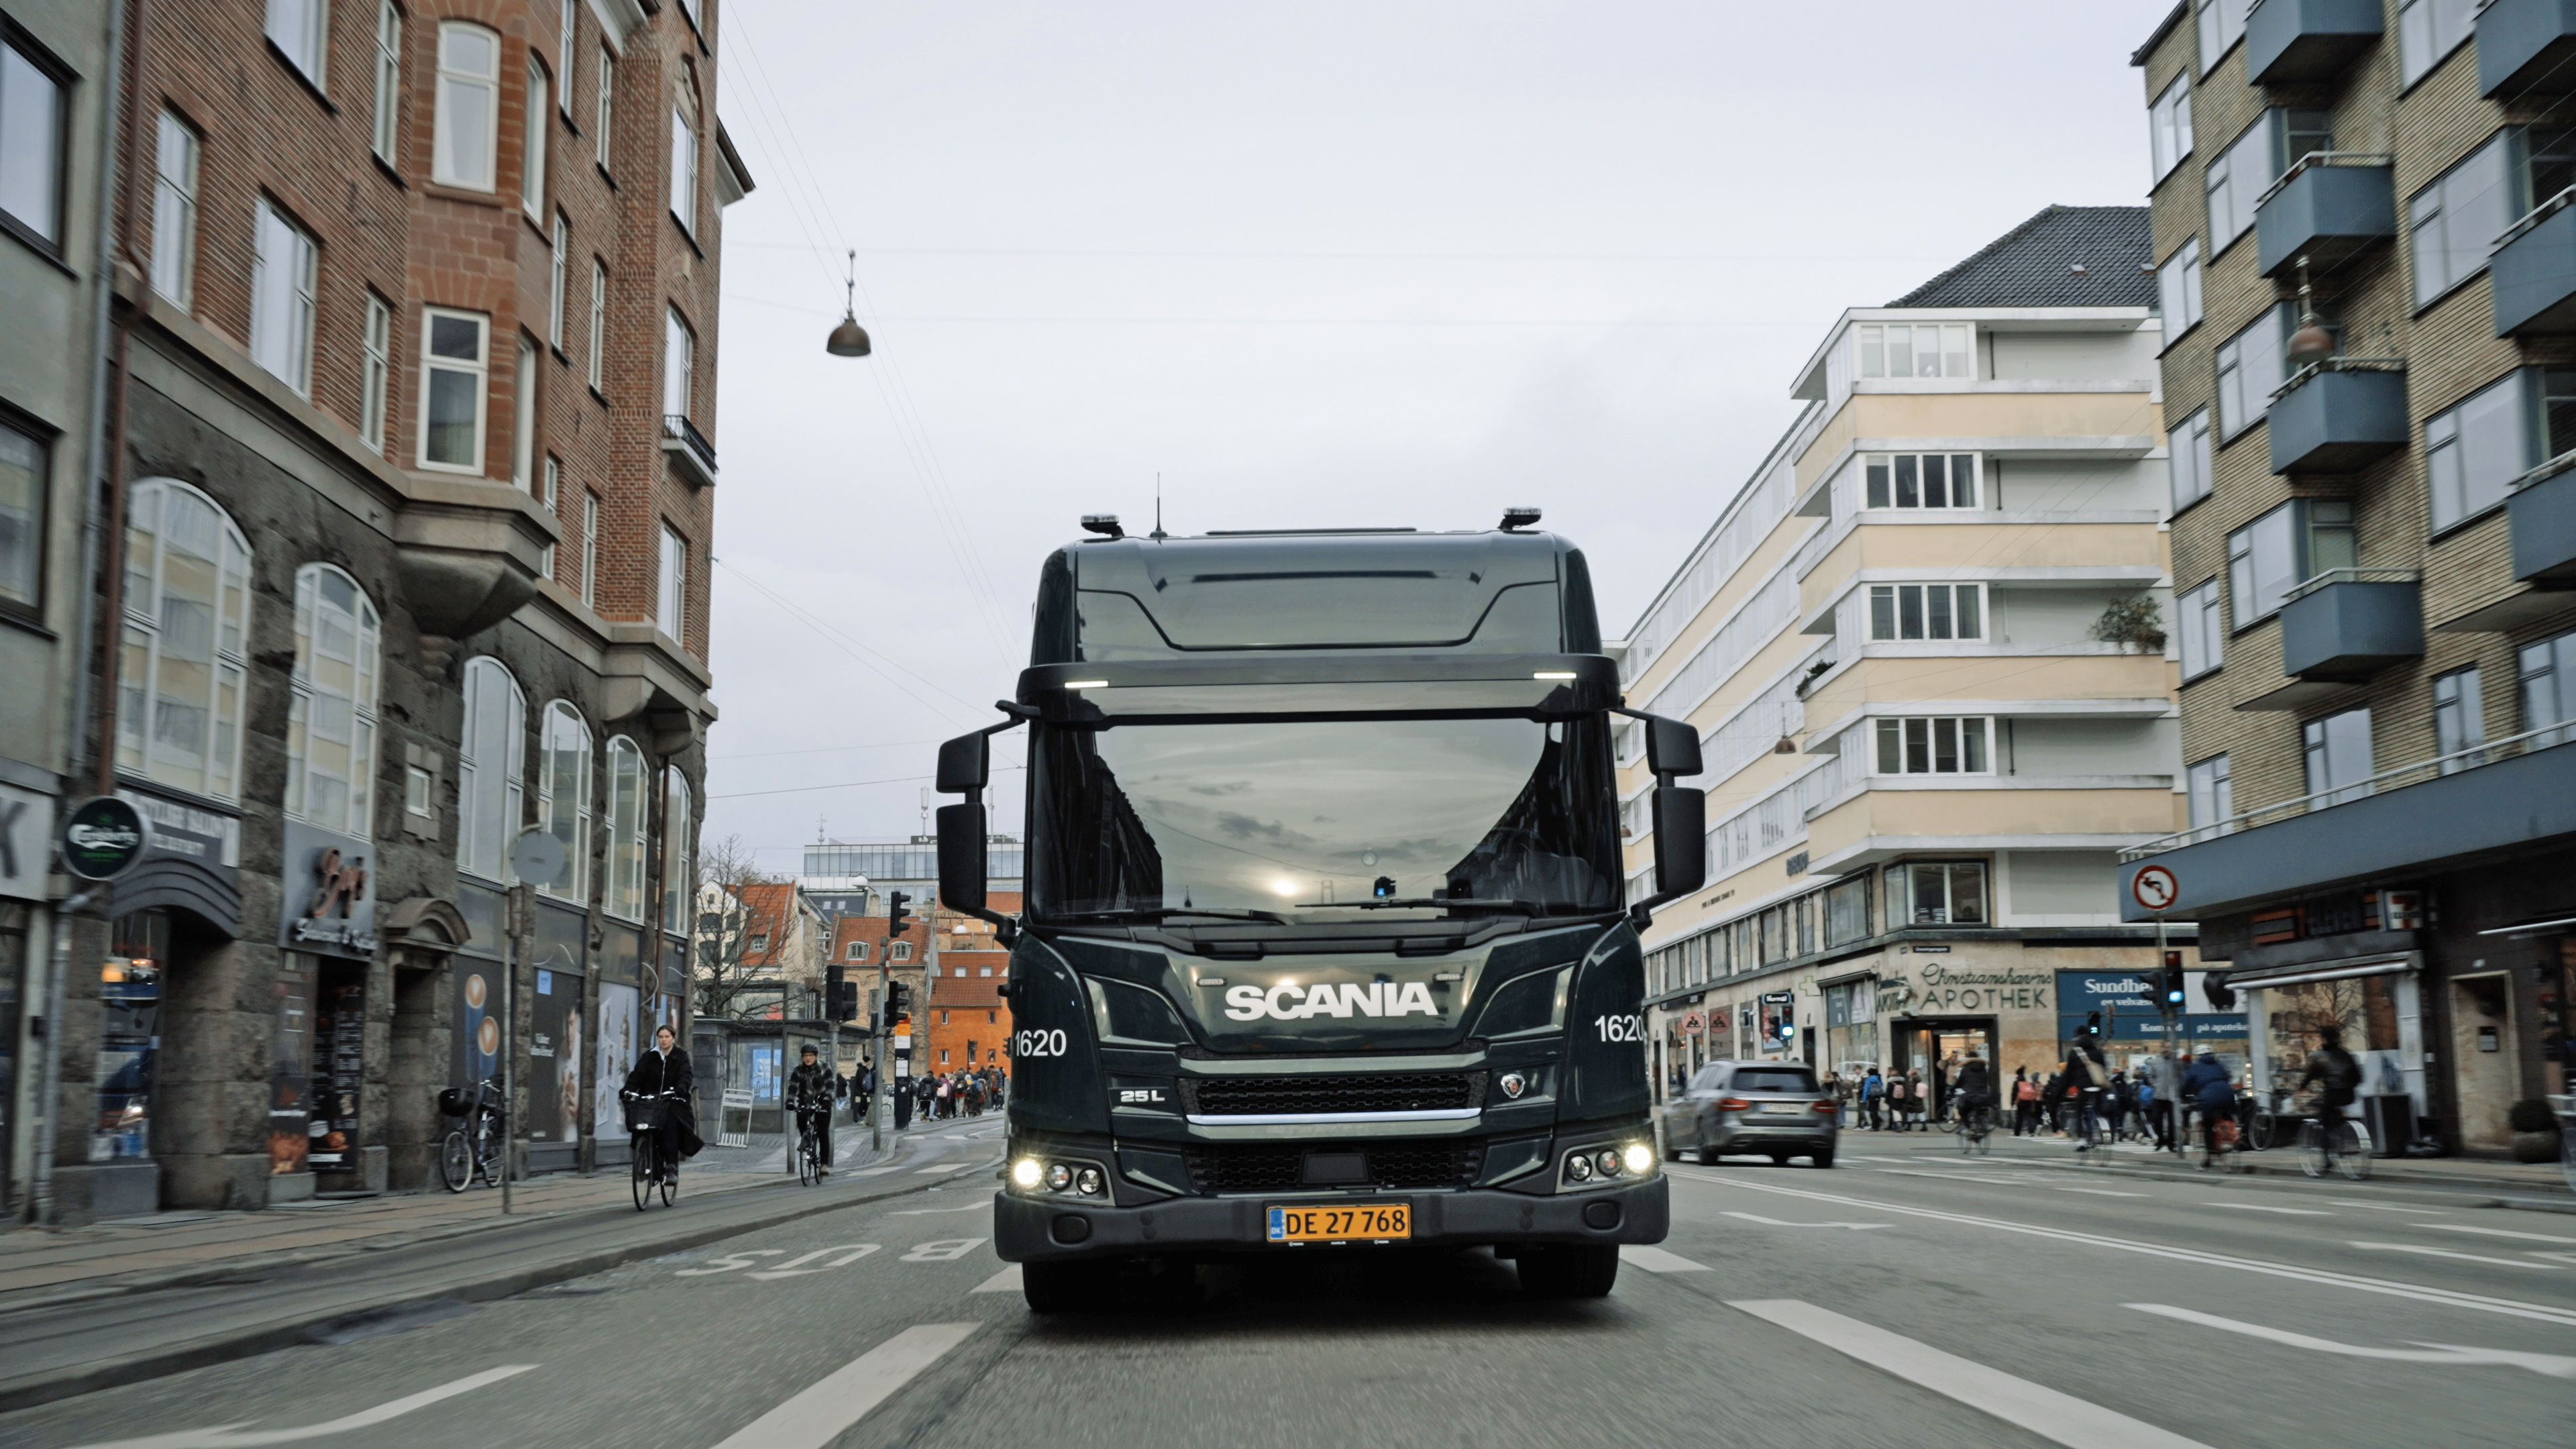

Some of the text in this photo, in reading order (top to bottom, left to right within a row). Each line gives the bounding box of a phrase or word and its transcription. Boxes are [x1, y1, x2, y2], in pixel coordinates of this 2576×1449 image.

[1224, 982, 1439, 1021] SCANIA
[1921, 989, 2047, 1009] APOTHEK
[1595, 1015, 1644, 1042] 1620
[1015, 1029, 1067, 1057] 1620
[1120, 1091, 1149, 1102] 25
[1271, 1226, 1281, 1235] DK
[1286, 1210, 1406, 1235] DE 27 768
